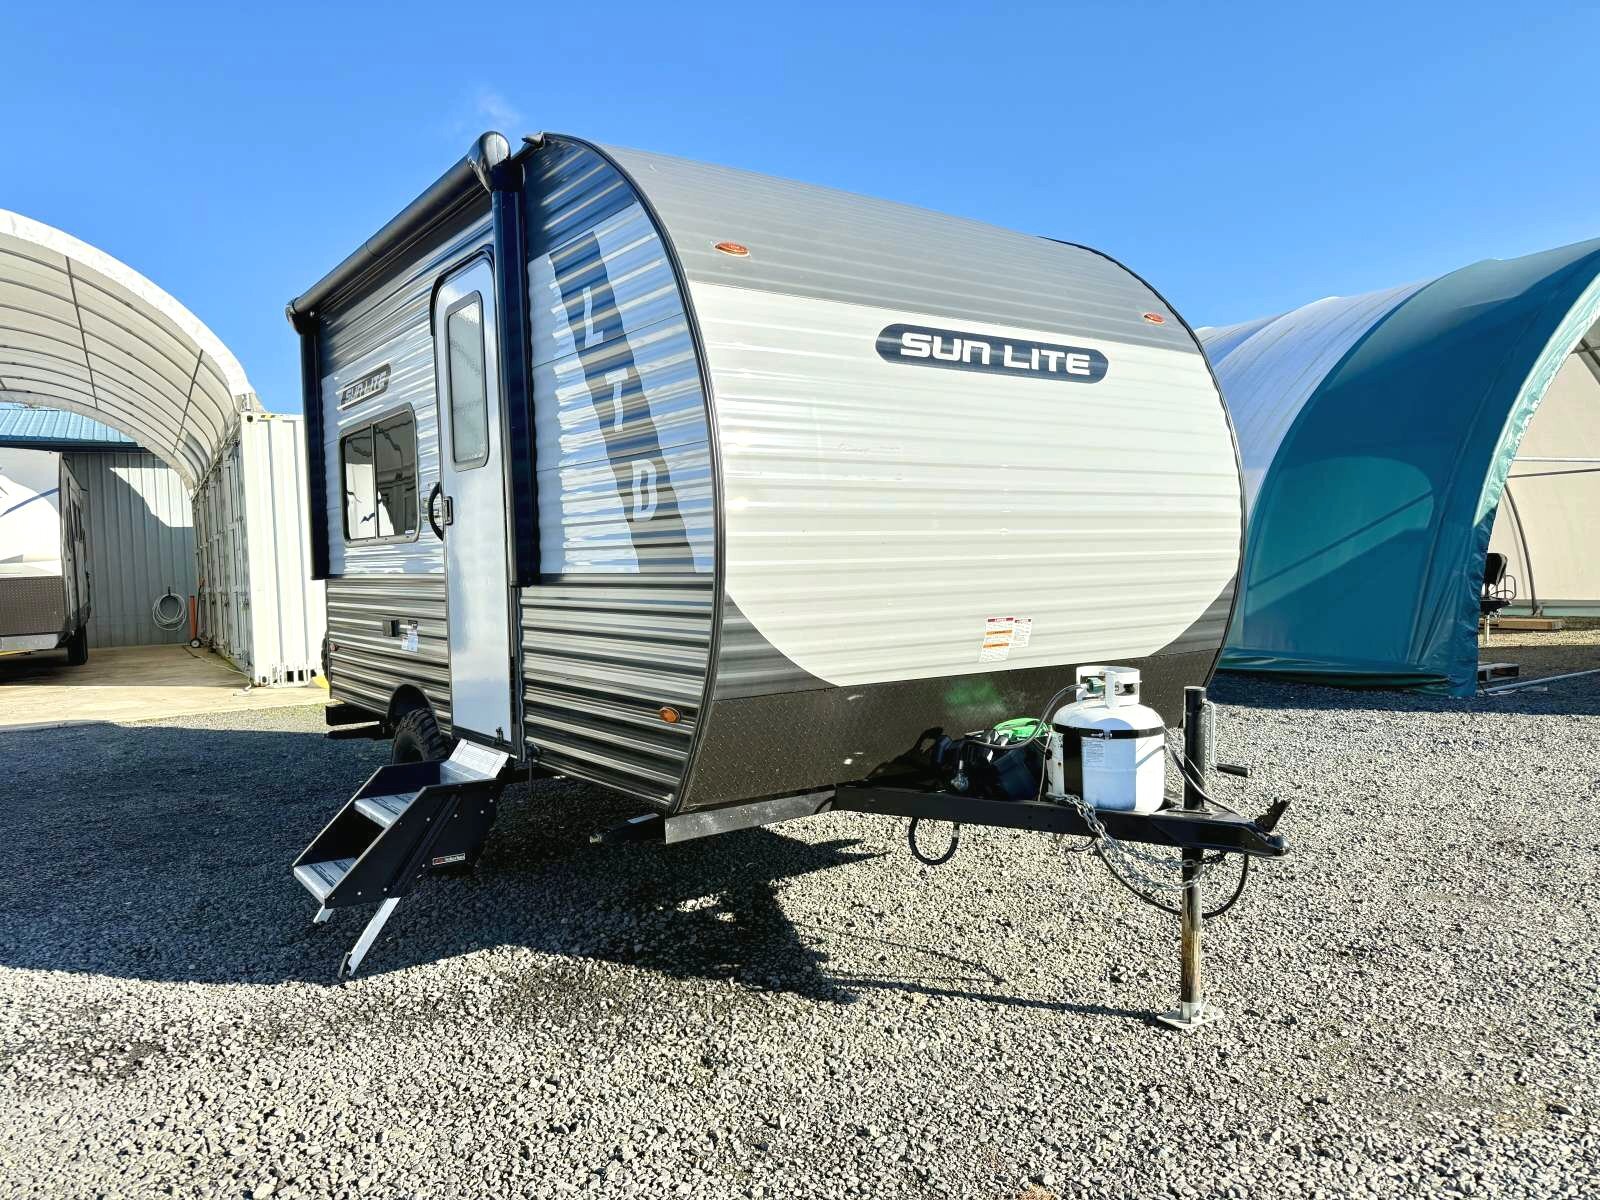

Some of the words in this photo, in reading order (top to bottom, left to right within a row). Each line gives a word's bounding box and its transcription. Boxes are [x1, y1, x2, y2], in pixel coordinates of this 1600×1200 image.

[583, 286, 658, 522] LTD
[900, 332, 991, 365] SUN
[1003, 344, 1091, 376] LITE
